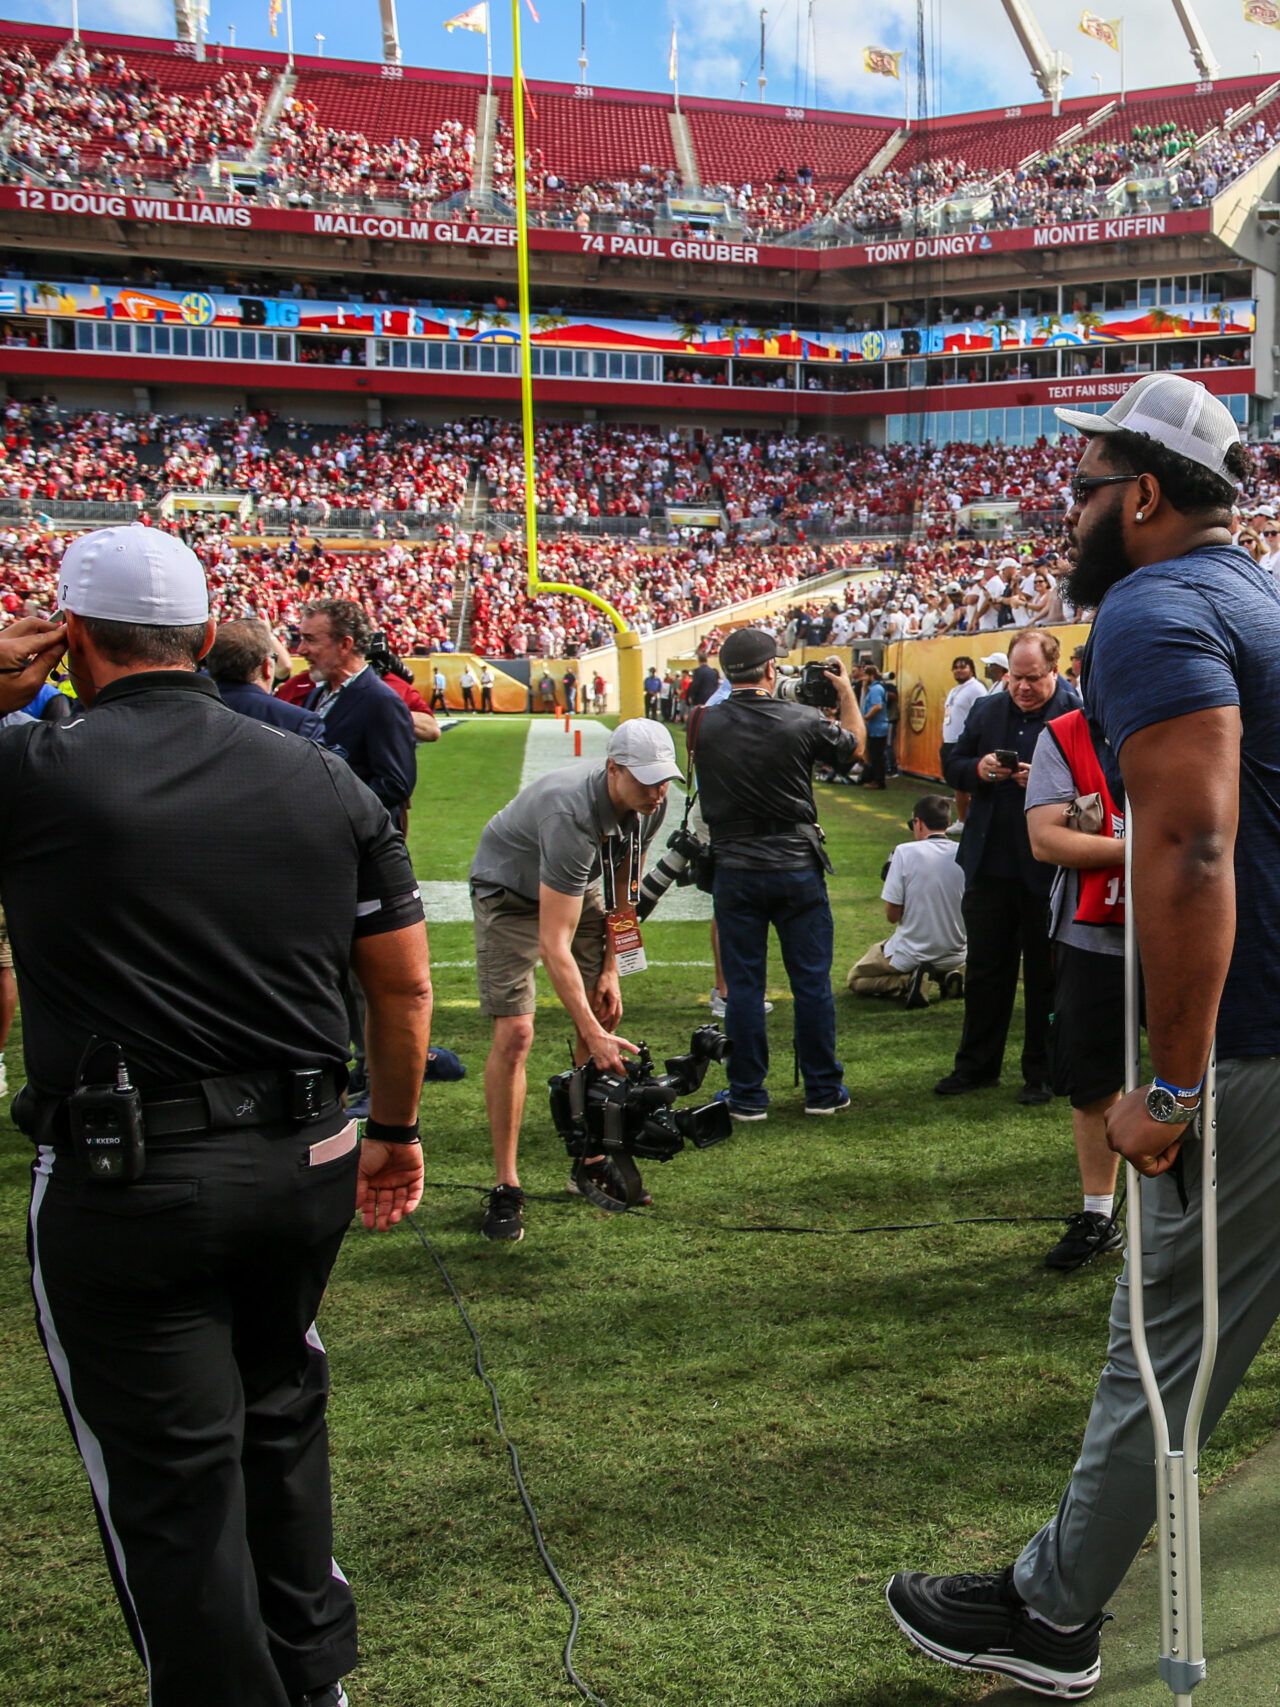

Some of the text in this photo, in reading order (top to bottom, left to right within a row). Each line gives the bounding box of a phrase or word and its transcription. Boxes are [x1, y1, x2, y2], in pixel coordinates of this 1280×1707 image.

[381, 66, 403, 77] 332
[574, 86, 594, 97] 331
[17, 190, 252, 227] 12 DOUG WILLIAMS
[313, 214, 429, 240] MALCOLM
[1033, 215, 1166, 246] MONTE KIFFIN
[580, 234, 759, 264] 74 PAUL GRUBER
[865, 235, 976, 263] TONY DUNGY
[1048, 386, 1074, 399] TEXT
[1075, 384, 1096, 397] FAN
